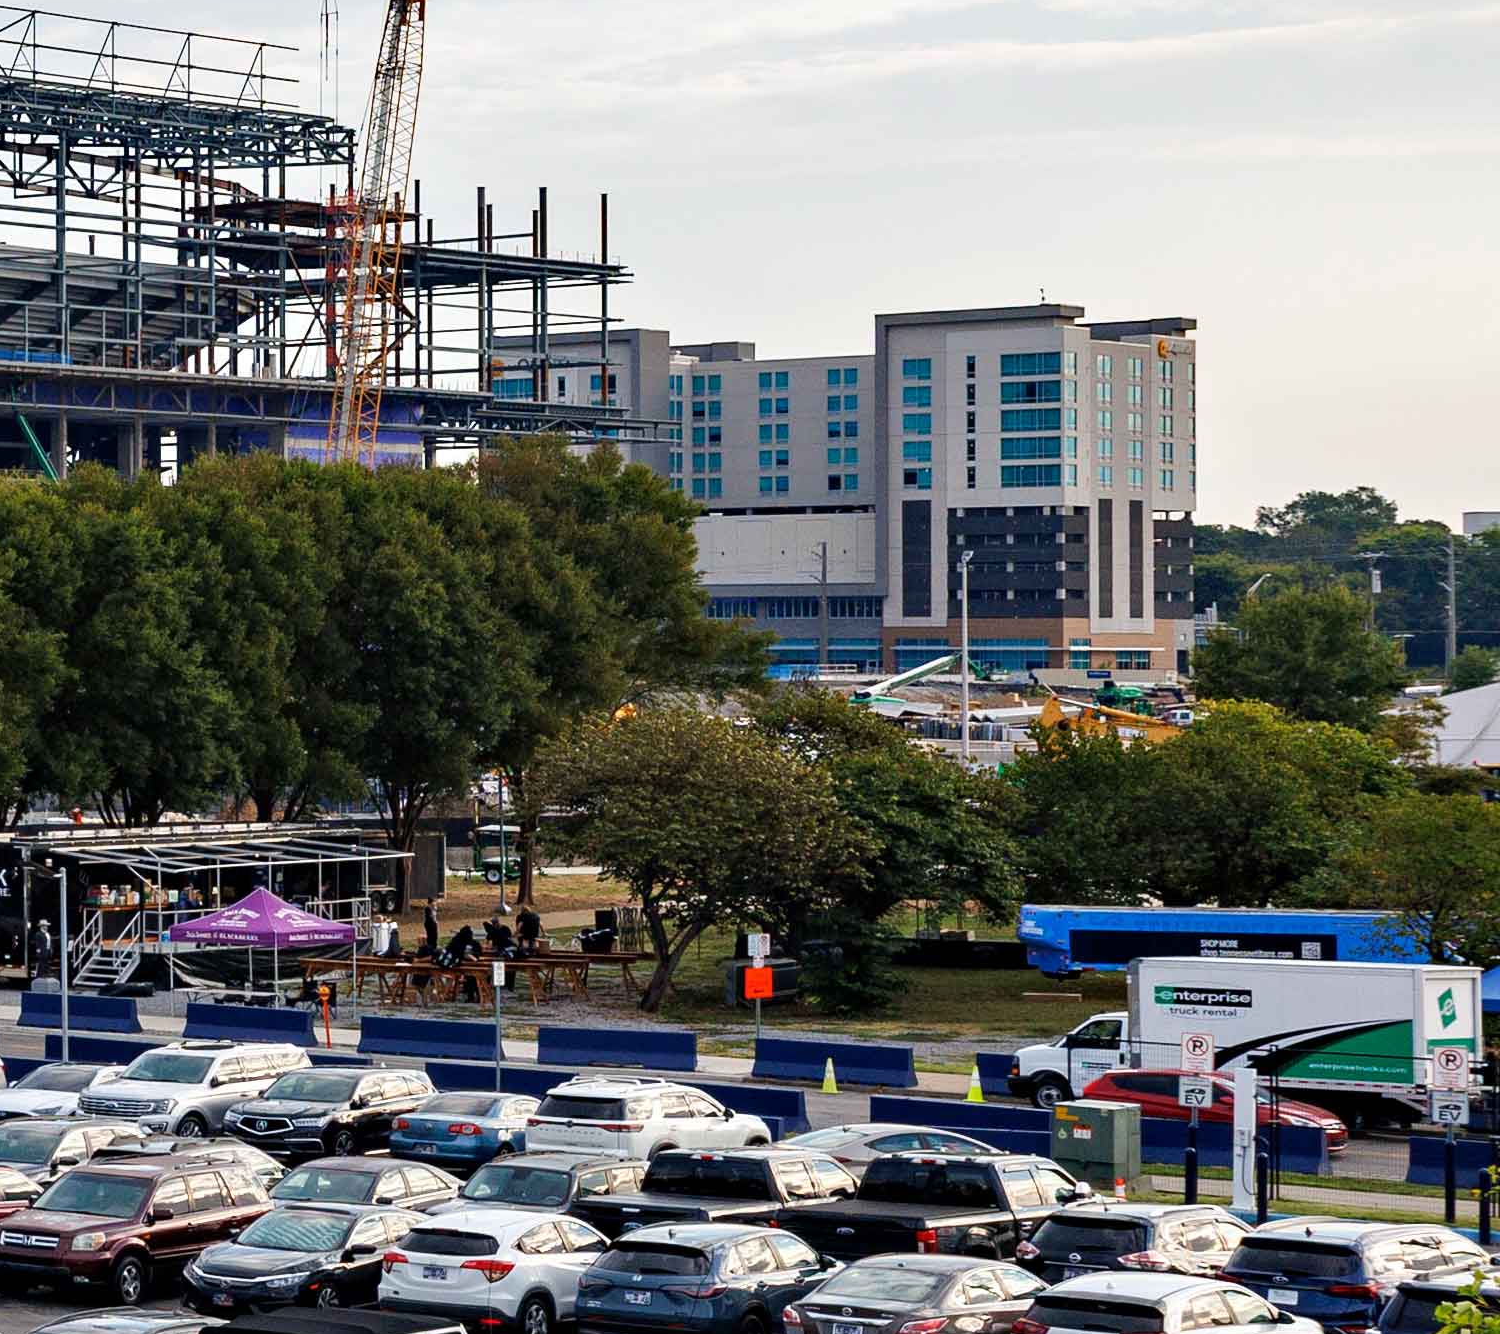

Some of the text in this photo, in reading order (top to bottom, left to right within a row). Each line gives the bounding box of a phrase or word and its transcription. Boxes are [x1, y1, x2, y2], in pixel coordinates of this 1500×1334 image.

[1200, 939, 1238, 948] SHOP MORE
[1155, 988, 1251, 1004] enterprise
[1169, 1007, 1237, 1017] truck rental
[1185, 1094, 1205, 1105] EV
[1438, 1110, 1460, 1122] EV
